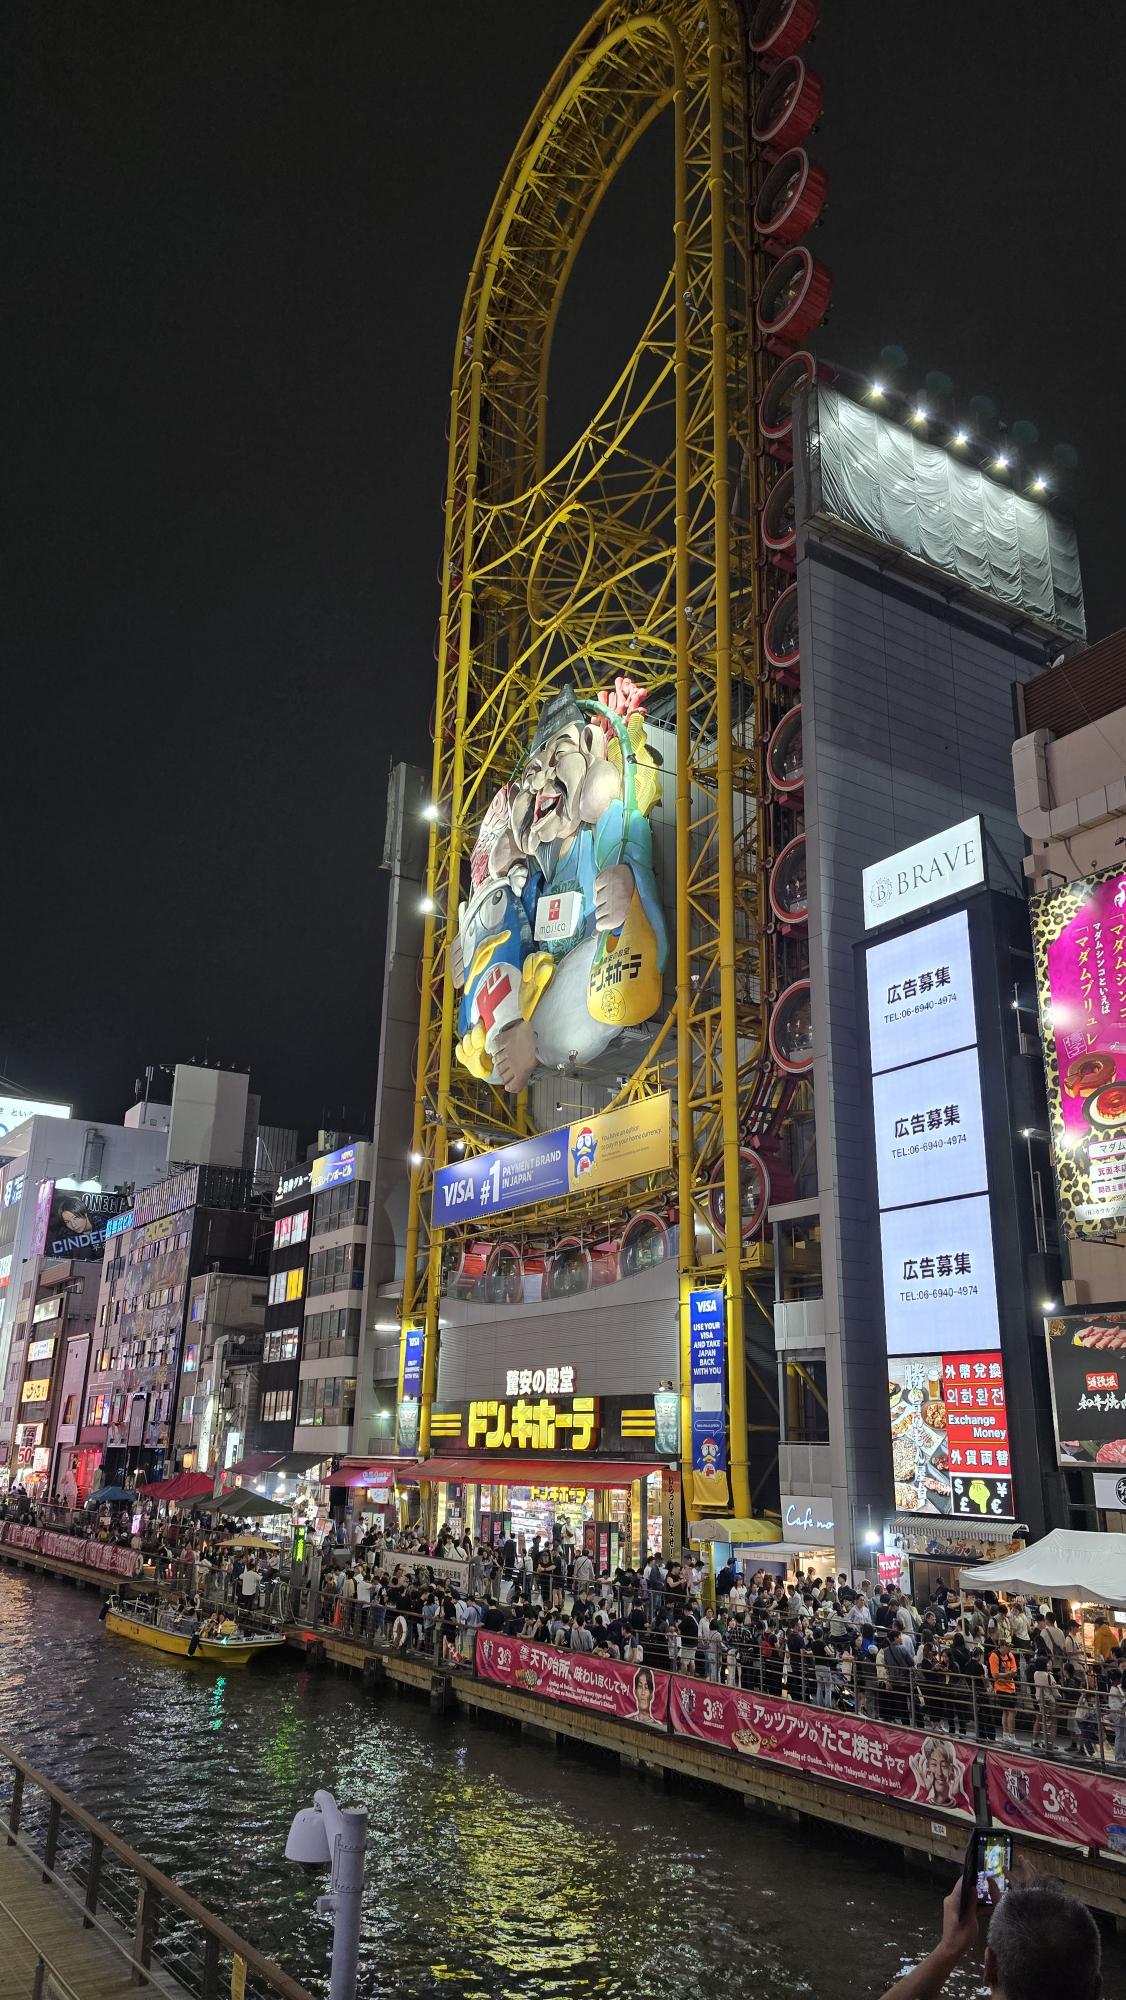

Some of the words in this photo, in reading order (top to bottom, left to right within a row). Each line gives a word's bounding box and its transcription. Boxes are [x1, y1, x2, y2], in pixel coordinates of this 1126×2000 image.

[897, 840, 976, 896] BRAVE
[887, 966, 951, 1005] 広告募集
[884, 992, 957, 1024] TEL:06-6940-4974
[894, 1104, 961, 1139] 広告募集
[891, 1134, 967, 1159] TEL:06-6940-4974
[502, 1158, 535, 1176] PAYMENT
[536, 1150, 562, 1168] BRAND
[442, 1178, 474, 1207] VISA
[480, 1160, 500, 1206] #1
[502, 1176, 510, 1188] IN
[902, 1252, 972, 1281] 広告募集
[900, 1285, 978, 1302] TEL:06-6940-4974
[696, 1300, 717, 1313] VISA
[694, 1322, 705, 1331] USE
[705, 1322, 720, 1330] YOUR
[700, 1331, 713, 1340] VISA
[694, 1341, 706, 1349] AND
[706, 1340, 721, 1348] TAKE
[698, 1349, 716, 1358] JAPAN
[700, 1358, 715, 1366] BACK
[694, 1367, 709, 1375] WITH
[709, 1366, 722, 1374] YOU
[506, 1366, 574, 1396] 驚安の殿堂
[946, 1387, 1005, 1407] 외화환전
[948, 1414, 996, 1426] Exchange
[973, 1427, 1007, 1440] Money
[950, 1450, 1009, 1466] 外貨両替
[786, 1504, 813, 1530] Cafe
